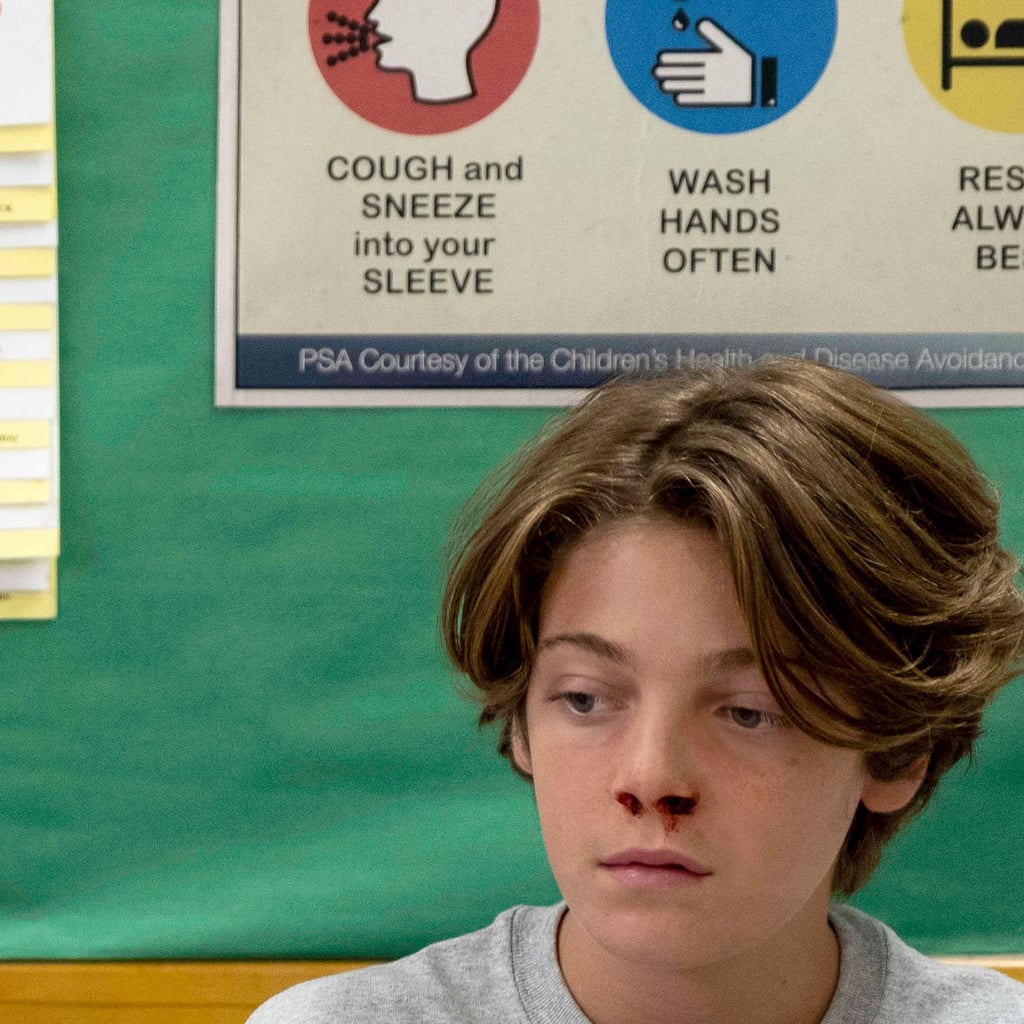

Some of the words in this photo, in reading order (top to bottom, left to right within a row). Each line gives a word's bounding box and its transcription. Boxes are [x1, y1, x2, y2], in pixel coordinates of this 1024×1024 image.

[327, 155, 454, 182] COUGH
[464, 155, 525, 181] and
[668, 168, 772, 195] WASH
[959, 165, 1024, 192] RES
[362, 193, 497, 219] SNEEZE
[951, 205, 1024, 231] ALW
[660, 207, 781, 234] HANDS
[354, 231, 415, 257] into
[423, 236, 497, 264] your
[662, 247, 777, 274] OFTEN
[976, 244, 1024, 270] BE
[363, 268, 494, 294] SLEEVE
[298, 347, 354, 373] PSA
[358, 347, 469, 378] Courtesy
[475, 347, 500, 373] of
[504, 347, 545, 373] the
[549, 346, 669, 374] Children's
[676, 347, 753, 371] Health
[815, 346, 909, 371] Disease
